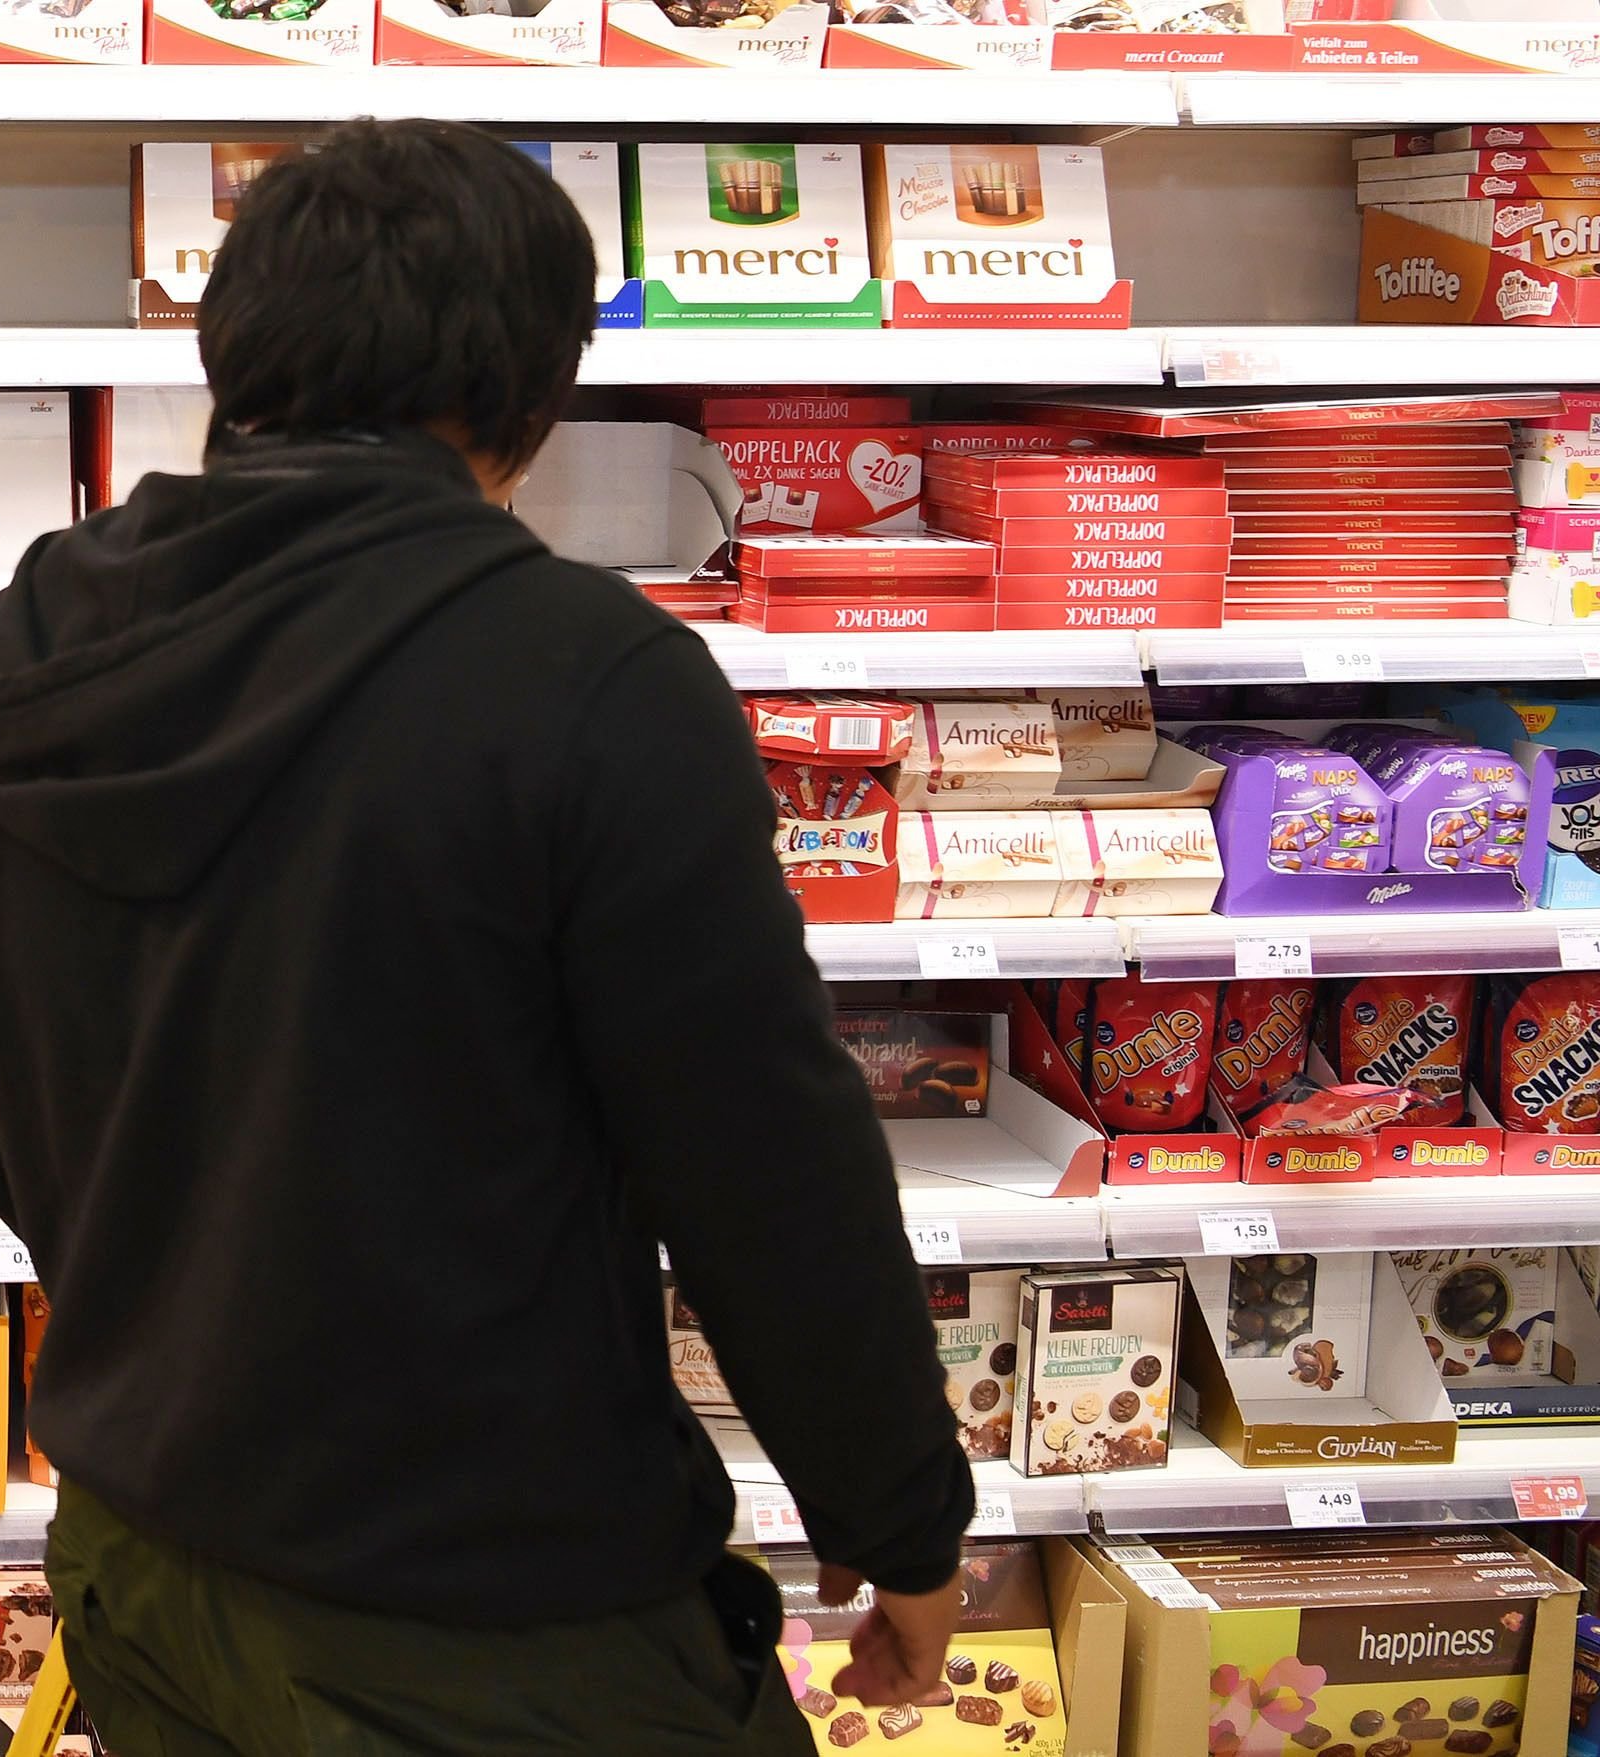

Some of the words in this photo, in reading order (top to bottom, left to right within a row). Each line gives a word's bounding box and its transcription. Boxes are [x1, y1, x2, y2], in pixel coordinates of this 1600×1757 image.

[1303, 36, 1340, 50] Vielfalt
[1343, 39, 1367, 50] zum
[1302, 50, 1362, 65] Anbieten
[1365, 51, 1376, 65] &
[1379, 51, 1419, 66] Teilen
[898, 177, 945, 198] Mousse
[900, 195, 950, 222] Chocolat
[674, 237, 839, 276] merci
[924, 238, 1083, 276] merci
[1374, 258, 1460, 302] Toffifee
[1498, 284, 1557, 307] Deutschland
[1349, 407, 1385, 420] merci
[754, 464, 773, 481] 2X
[775, 467, 807, 480] DANKE
[809, 466, 841, 480] SAGEN
[862, 460, 912, 489] -20%
[1064, 464, 1156, 484] DOPPELPACK
[1067, 493, 1159, 513] DOPPELPACK
[1074, 521, 1165, 540] DOPPELPACK
[1071, 550, 1162, 569] DOPPELPACK
[821, 661, 857, 675] 4,99
[1336, 654, 1372, 667] 9,99
[942, 722, 1047, 746] Amicelli
[1312, 769, 1359, 787] NAPS
[1472, 766, 1515, 783] NAPS
[1025, 798, 1086, 808] Amicelli
[943, 830, 1047, 855] Amicelli
[1104, 828, 1207, 854] Amicelli
[1569, 827, 1595, 841] fills
[1366, 882, 1414, 905] Milka
[952, 945, 987, 959] 2,79
[1268, 944, 1302, 959] 2,79
[1091, 1009, 1202, 1094] Dumle
[1355, 1002, 1460, 1086] SNACKS
[1418, 1065, 1460, 1079] original
[1147, 1146, 1226, 1174] Dumle
[1285, 1146, 1363, 1173] Dumle
[1410, 1140, 1490, 1166] Dumle
[915, 1231, 950, 1246] 1,19
[1234, 1224, 1269, 1239] 1,59
[1054, 1302, 1109, 1320] Sarotti
[1047, 1337, 1088, 1359] KLEINE
[1090, 1334, 1143, 1356] FREUDEN
[1318, 1493, 1352, 1508] 4,49
[1543, 1486, 1579, 1501] 1,99
[1477, 1566, 1538, 1580] happiness
[1499, 1580, 1559, 1594] happiness
[1359, 1622, 1496, 1665] happiness
